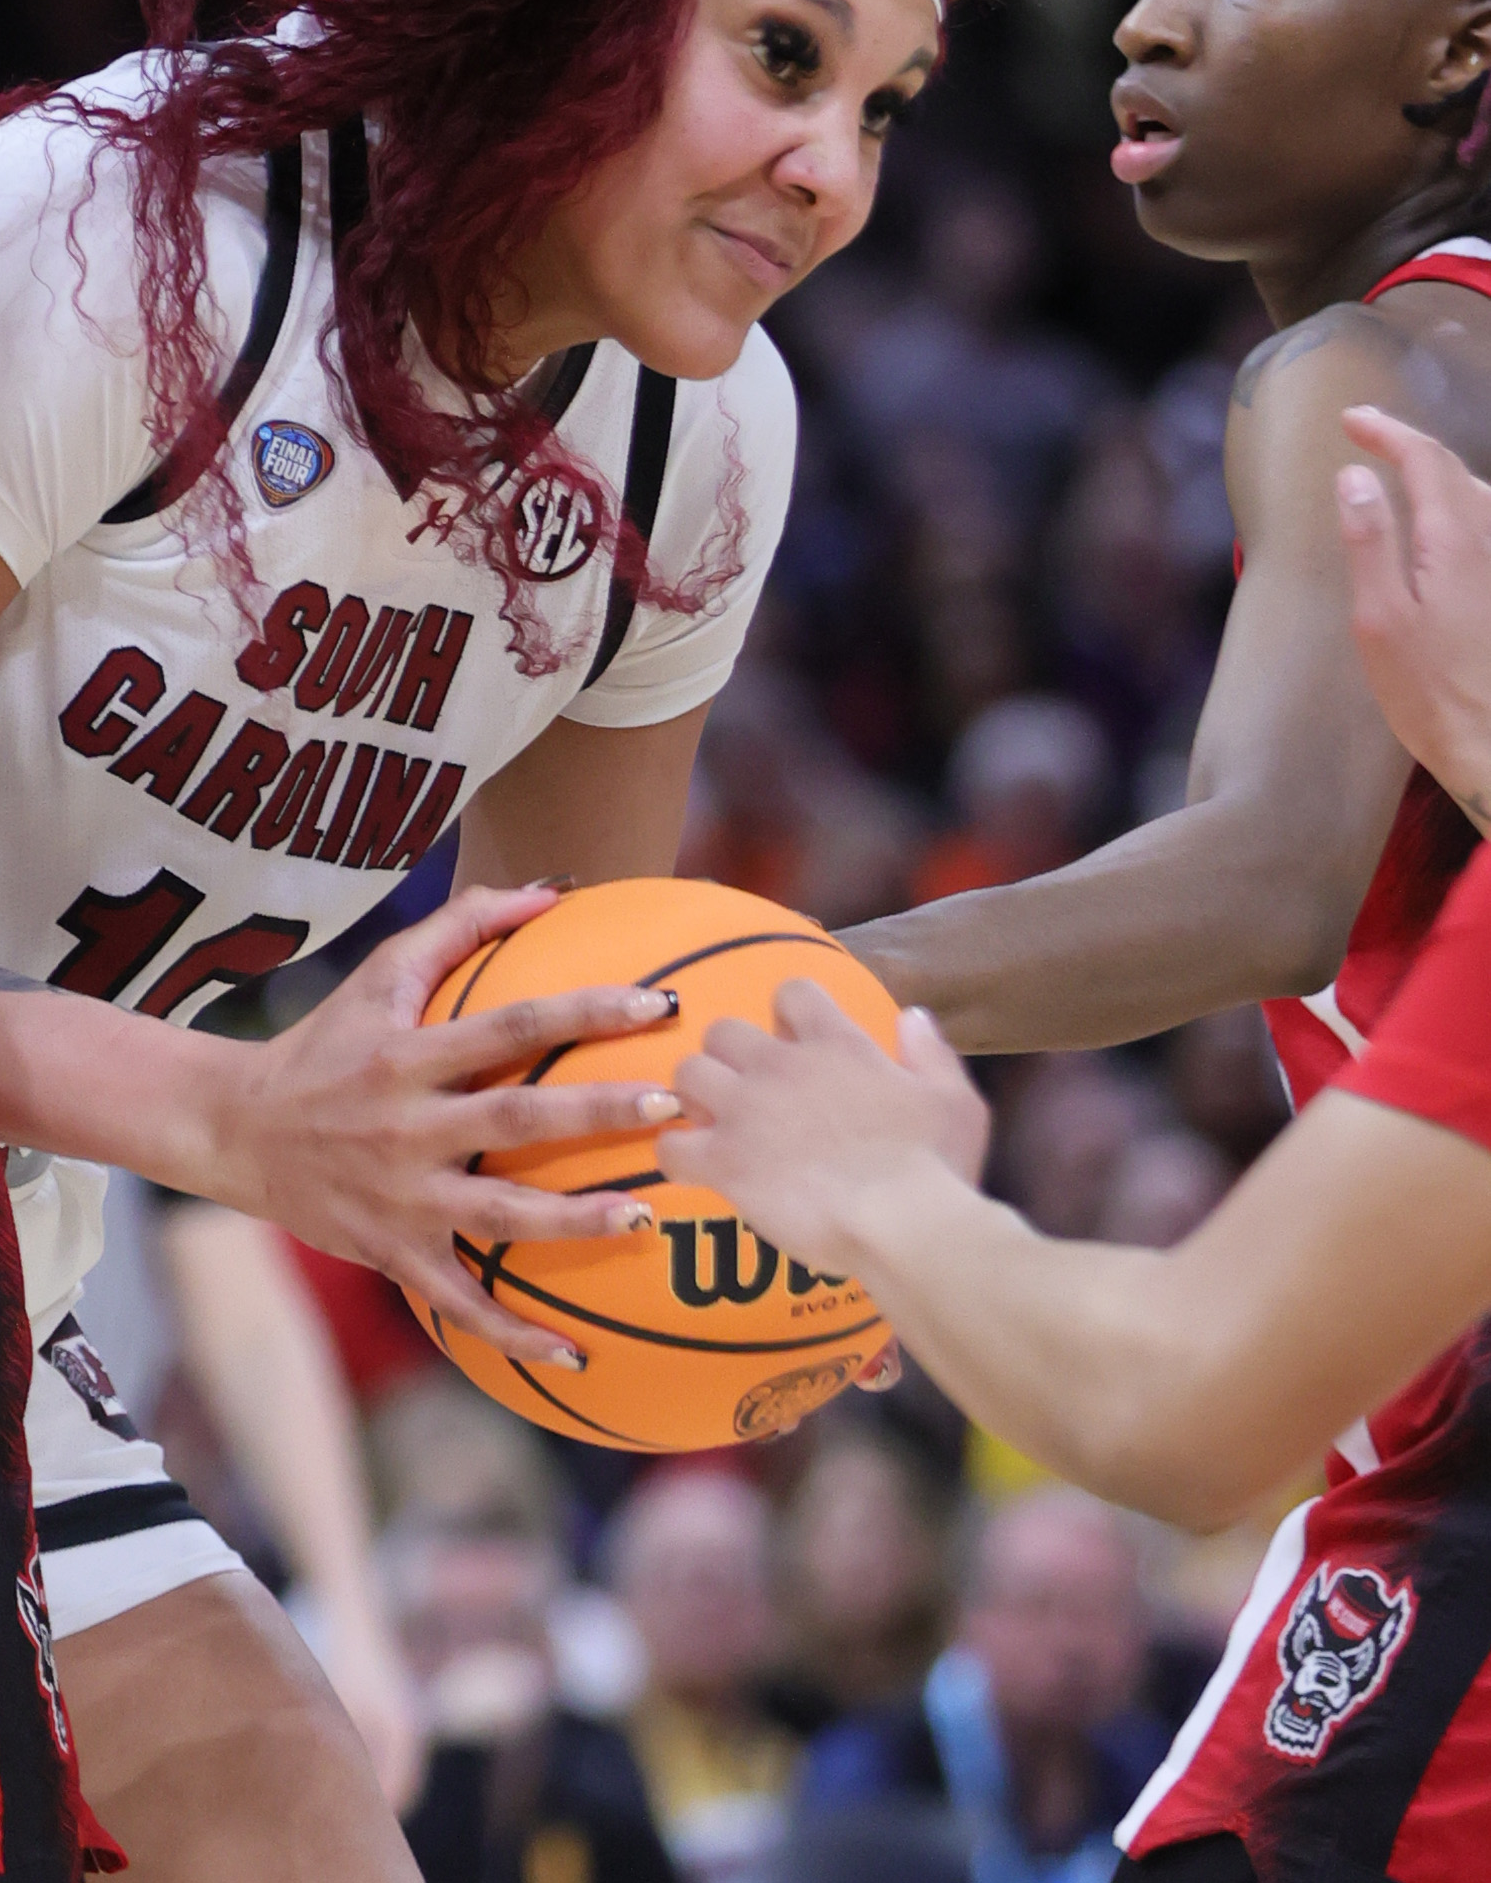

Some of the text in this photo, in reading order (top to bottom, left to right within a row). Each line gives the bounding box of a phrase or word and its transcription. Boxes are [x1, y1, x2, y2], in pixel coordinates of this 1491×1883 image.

[262, 451, 309, 486] FOUR
[269, 435, 315, 469] FINAL
[514, 474, 594, 575] SEC
[58, 645, 467, 871] CAROLINA
